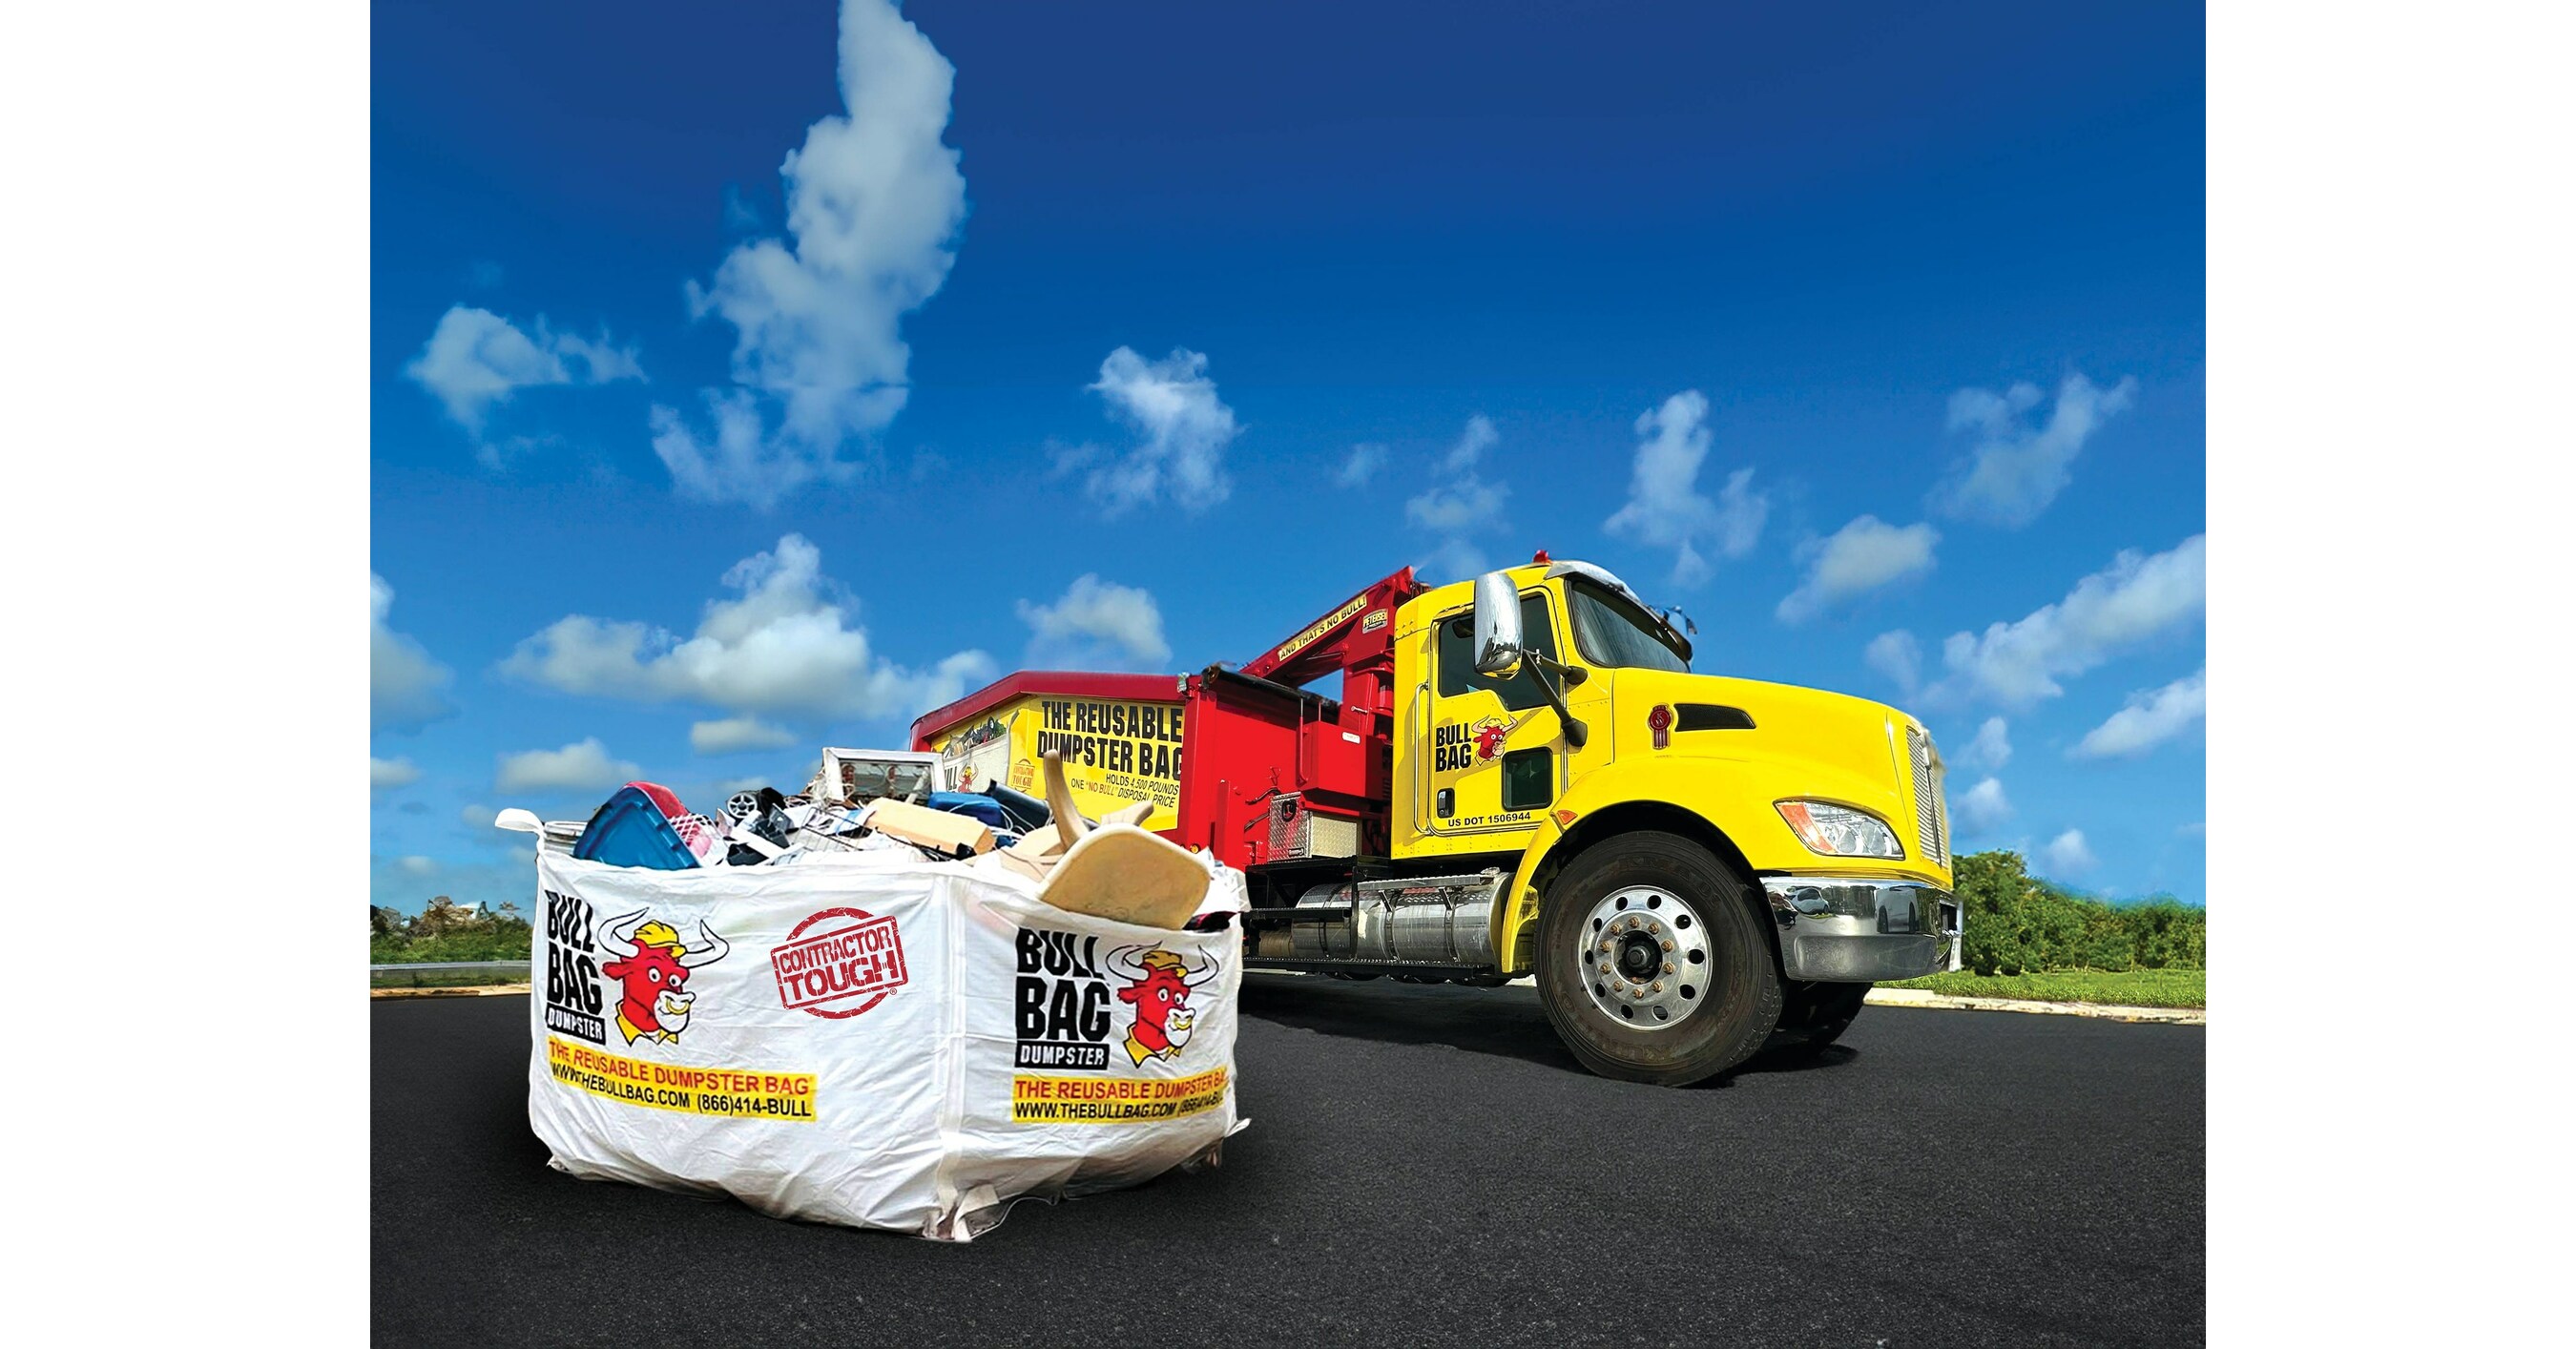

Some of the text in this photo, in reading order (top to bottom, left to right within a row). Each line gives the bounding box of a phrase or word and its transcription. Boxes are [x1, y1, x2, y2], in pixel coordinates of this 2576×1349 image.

[1280, 596, 1366, 658] AND THAT'S NO BULL!
[1042, 701, 1183, 743] THE REUSABLE
[1436, 723, 1471, 747] BULL
[1037, 731, 1182, 781] DUMPSTER BAG
[1435, 743, 1471, 772] BAG
[1071, 778, 1085, 790] ONE
[1152, 794, 1175, 808] PRICE
[1106, 773, 1179, 796] HOLDS 4,500 POUNDS
[1448, 812, 1531, 827] US DOT 1506944
[545, 890, 595, 953] BULL
[779, 925, 893, 974] CONTRACTOR
[1015, 927, 1107, 979] BULL
[547, 941, 603, 1016] BAG
[783, 950, 900, 1001] TOUGH
[547, 1007, 603, 1041] DUMPSTER
[1015, 976, 1111, 1042] BAG
[549, 1041, 809, 1095] THE REUSABLE DUMPSTER BAG
[1019, 1044, 1105, 1066] DUMPSTER
[697, 1093, 812, 1117] (866)414-BULL
[1015, 1080, 1050, 1099] THE
[1058, 1081, 1151, 1099] REUSABLE
[1155, 1074, 1213, 1100] DUMPSTER
[1015, 1102, 1176, 1118] WWW.THEBULLBAG.COM
